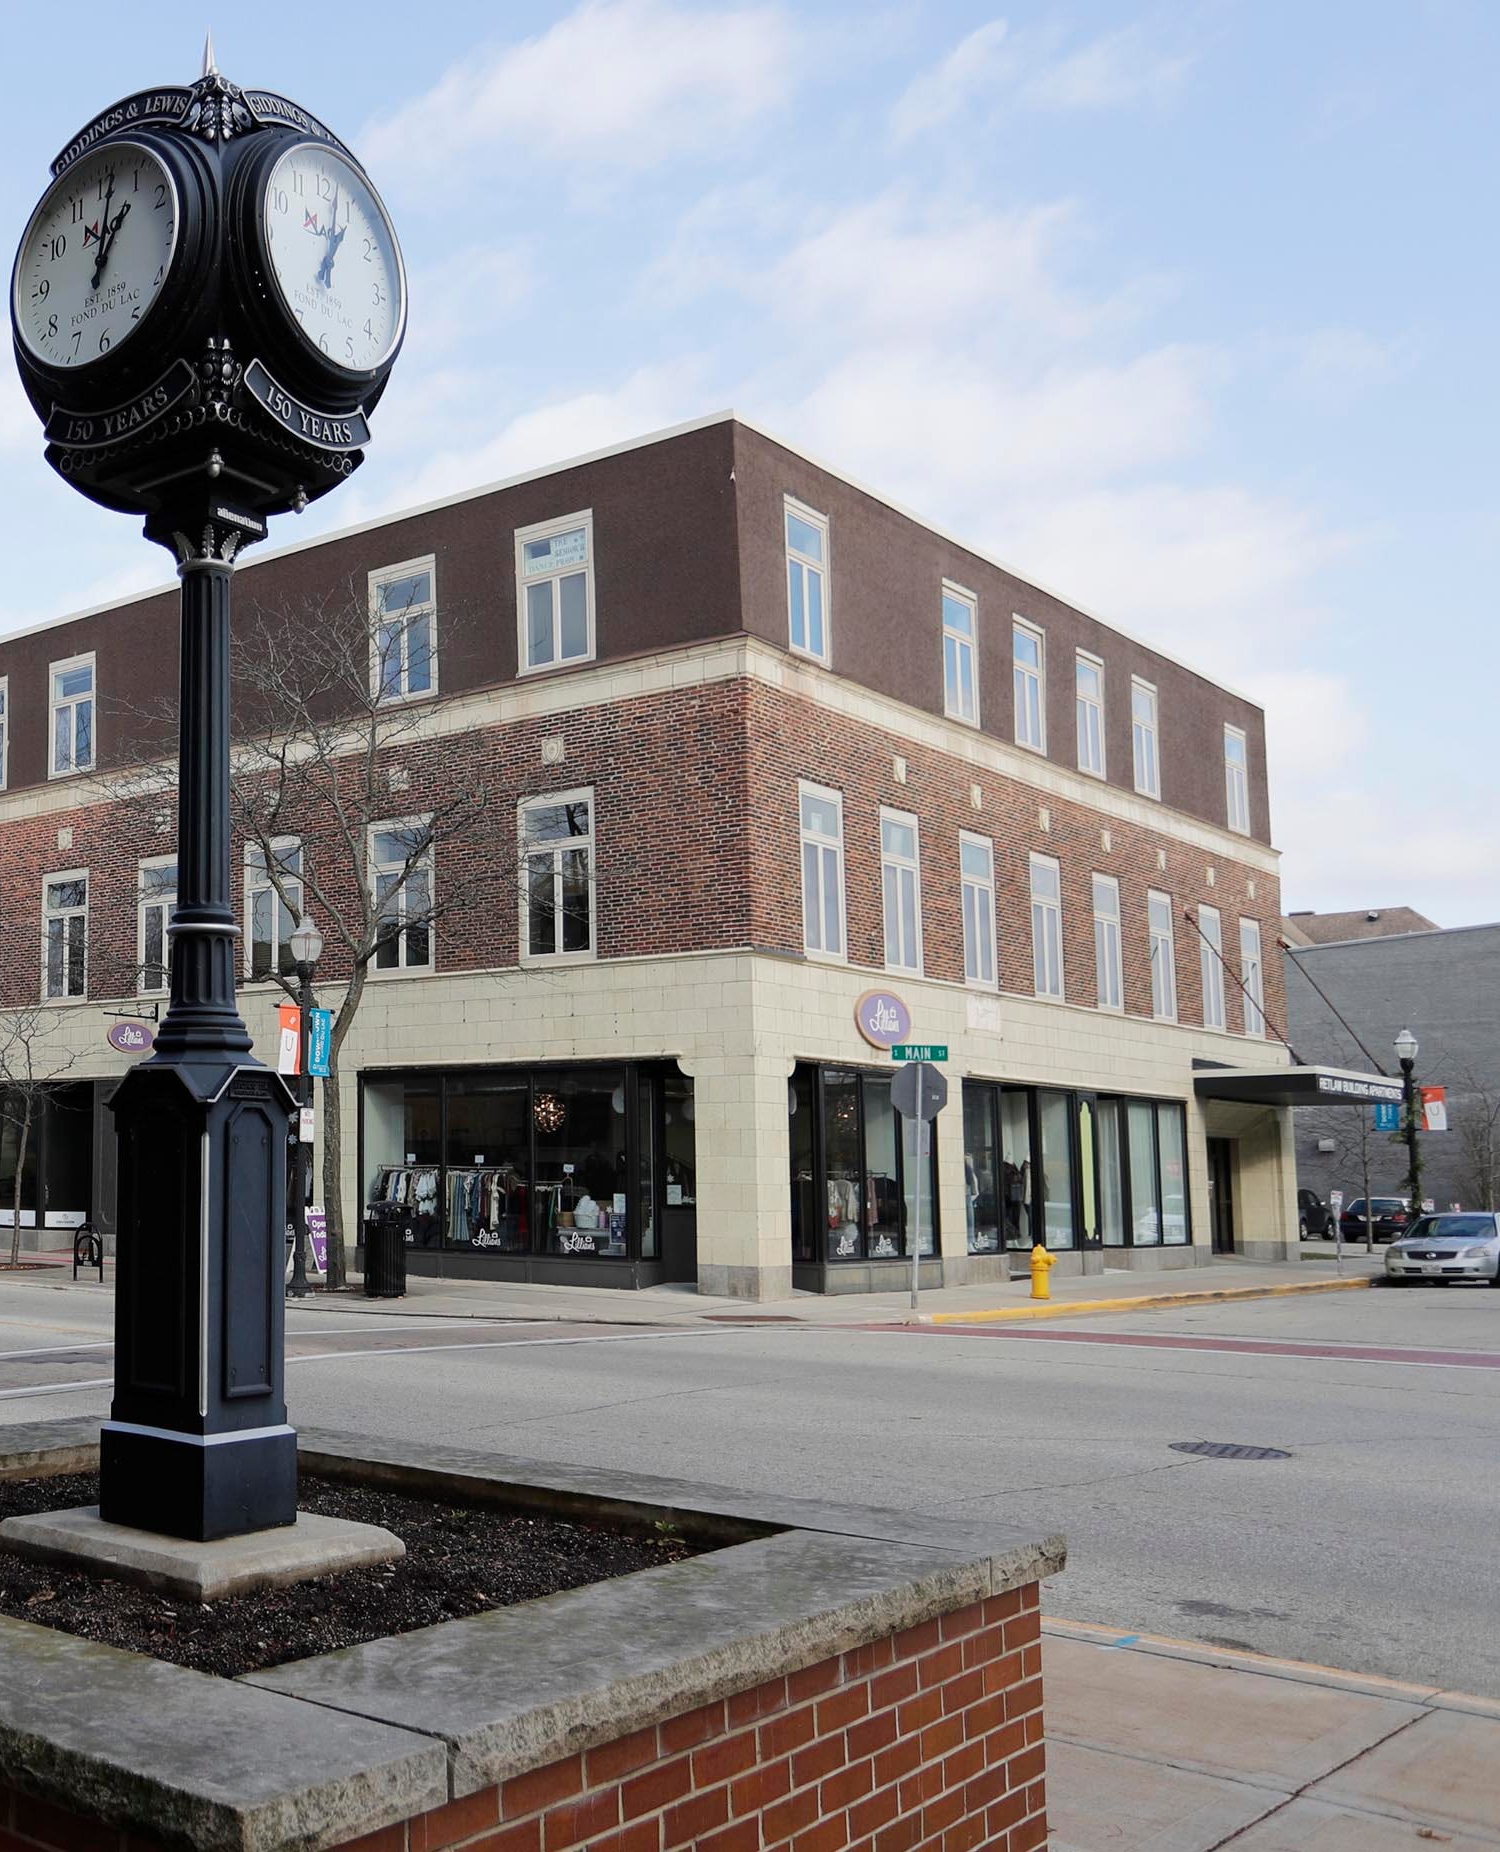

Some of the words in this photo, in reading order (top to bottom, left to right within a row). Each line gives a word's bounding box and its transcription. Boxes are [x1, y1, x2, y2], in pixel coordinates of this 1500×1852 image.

[250, 96, 308, 127] GIDDINGS
[55, 109, 123, 176] GIDDINGS
[126, 103, 139, 119] &
[144, 95, 188, 114] LEWIS
[132, 169, 139, 193] 1
[292, 170, 303, 197] 11
[316, 173, 332, 202] 12
[154, 184, 166, 210] 2
[274, 186, 288, 215] 10
[71, 198, 84, 224] 11
[345, 201, 351, 224] 1
[50, 234, 67, 262] 10
[363, 238, 372, 262] 2
[39, 279, 50, 304] 9
[84, 292, 103, 308] EST.
[107, 282, 127, 297] 1859
[372, 283, 380, 305] 3
[71, 307, 97, 327] FOND
[101, 301, 116, 314] DU
[120, 289, 140, 305] LAC
[293, 289, 318, 310] FOND
[321, 305, 333, 319] DU
[337, 312, 354, 329] LAC
[48, 314, 58, 338] 8
[363, 318, 372, 341] 4
[71, 331, 82, 356] 7
[99, 327, 111, 353] 6
[318, 332, 329, 354] 6
[345, 336, 354, 359] 5
[65, 420, 93, 440] 150
[103, 386, 168, 436] YEARS
[265, 386, 291, 420] 150
[299, 411, 352, 443] YEARS
[905, 1047, 931, 1059] MAIN
[1319, 1077, 1342, 1092] RETLAW
[1342, 1081, 1368, 1096] BUILDING
[1369, 1084, 1402, 1100] APARTMENTS
[312, 1230, 327, 1239] Toda
